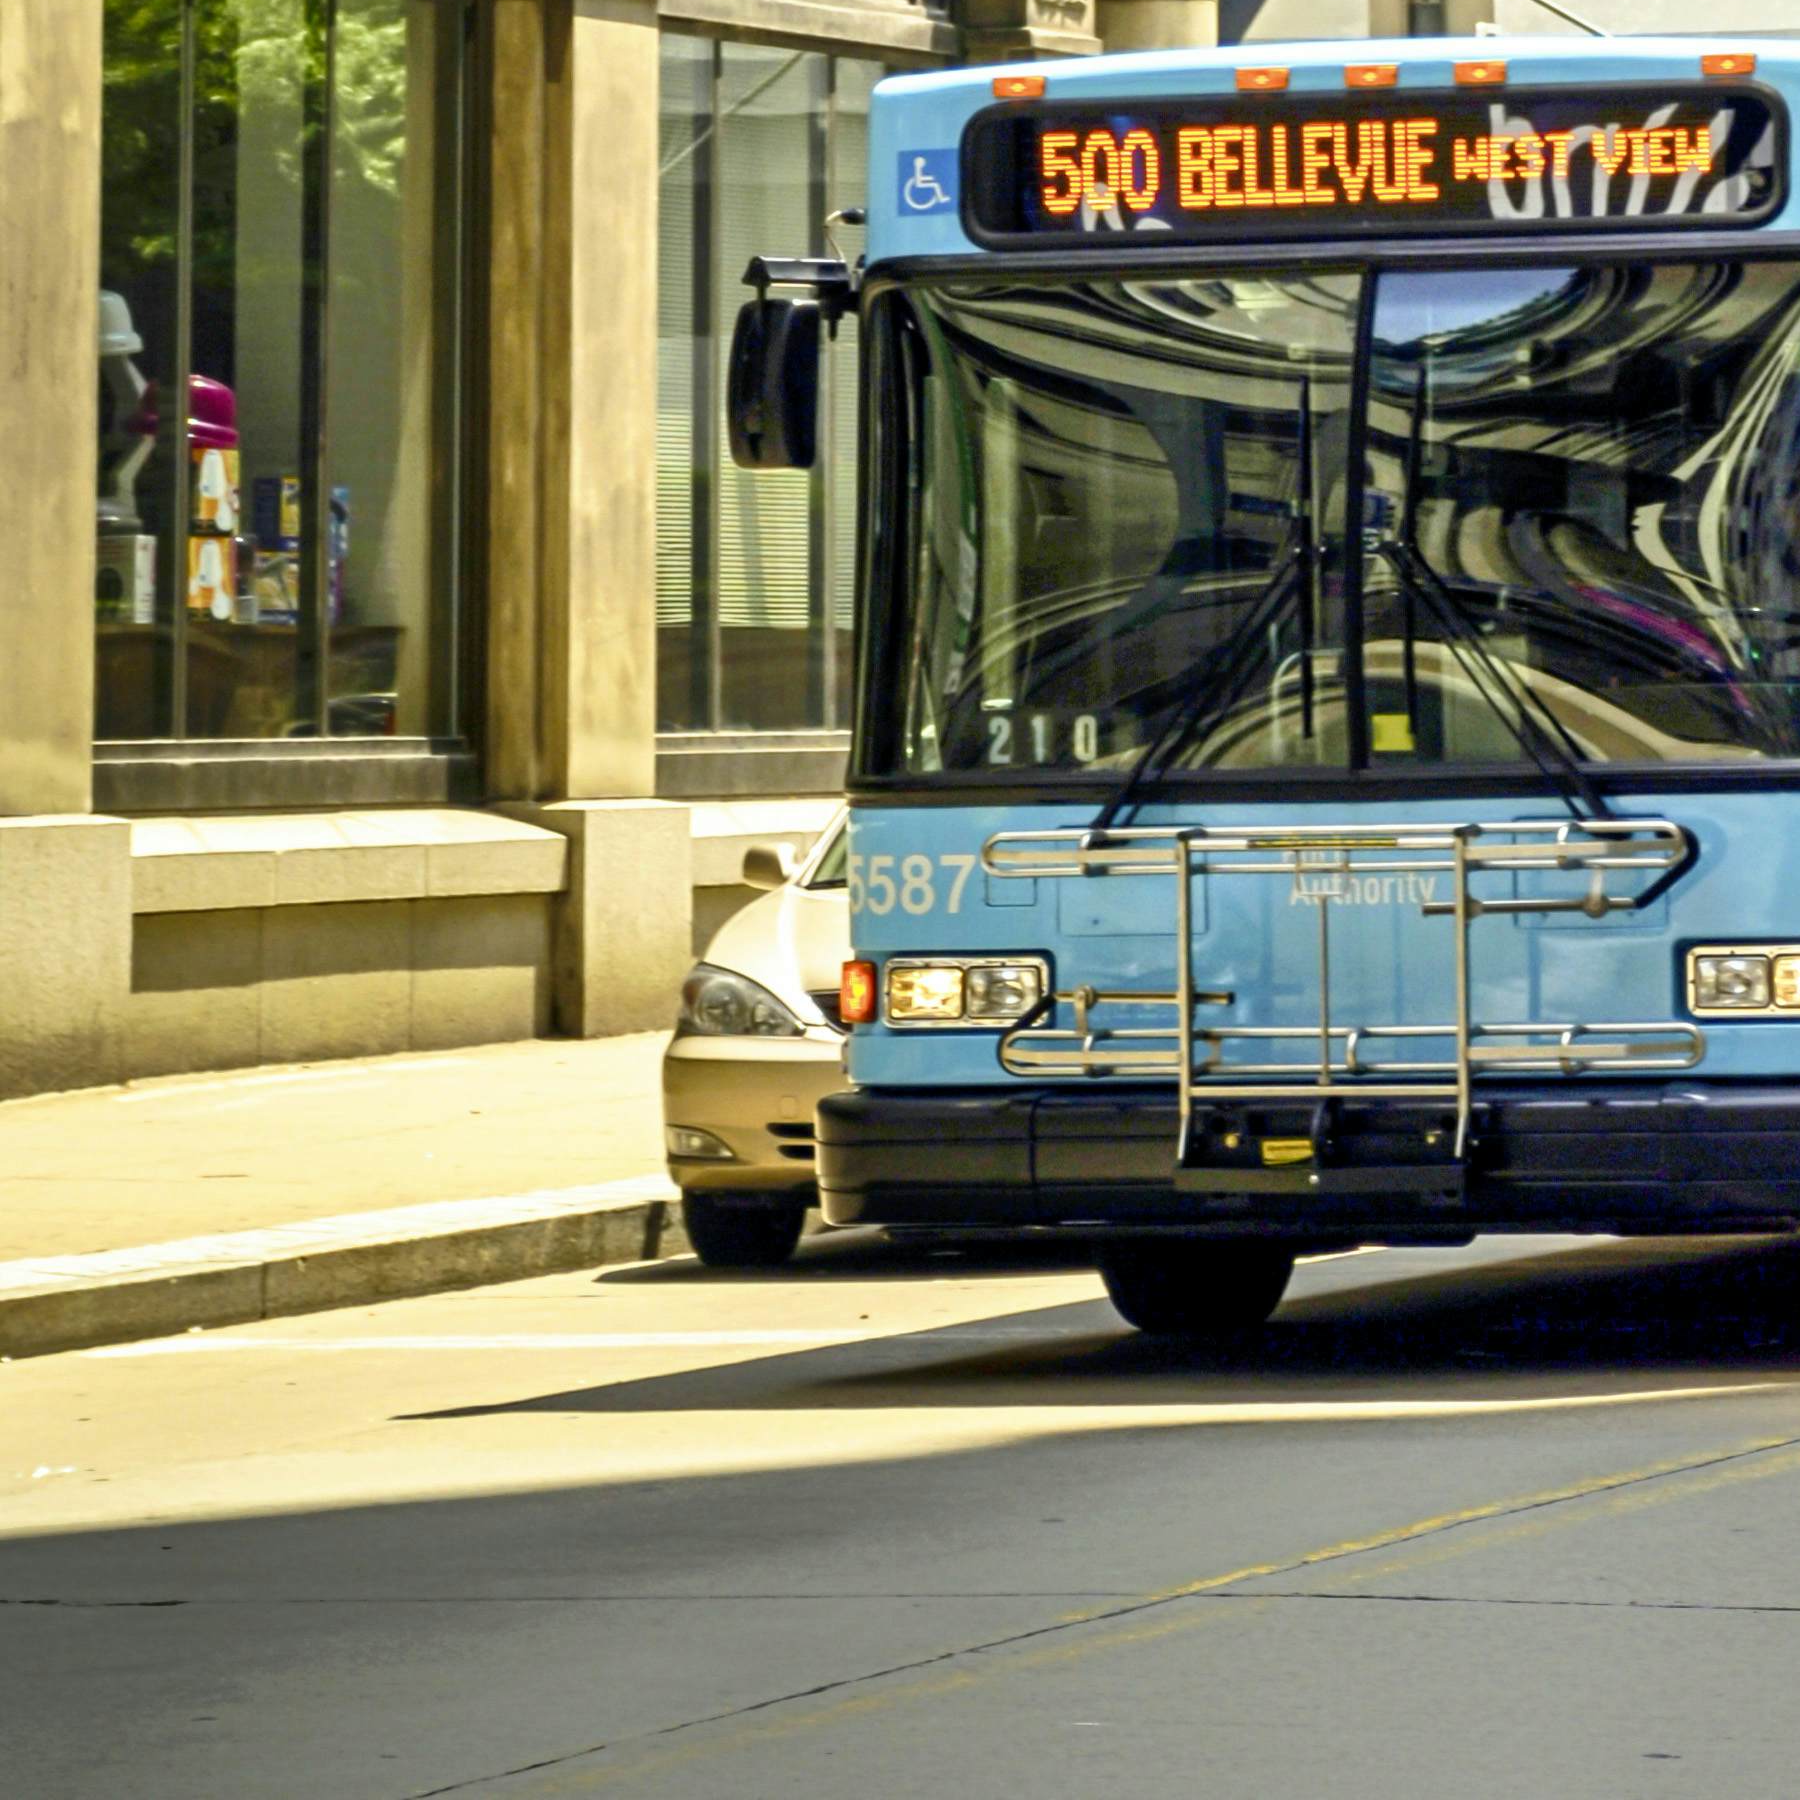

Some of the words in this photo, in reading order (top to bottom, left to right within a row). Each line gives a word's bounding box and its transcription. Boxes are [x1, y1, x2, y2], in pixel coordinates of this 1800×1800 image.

[1042, 129, 1160, 214] 500
[1178, 117, 1440, 208] BELLEVUE
[1453, 133, 1576, 180] WEST
[1590, 128, 1712, 175] VIEW
[1290, 871, 1437, 907] Authority
